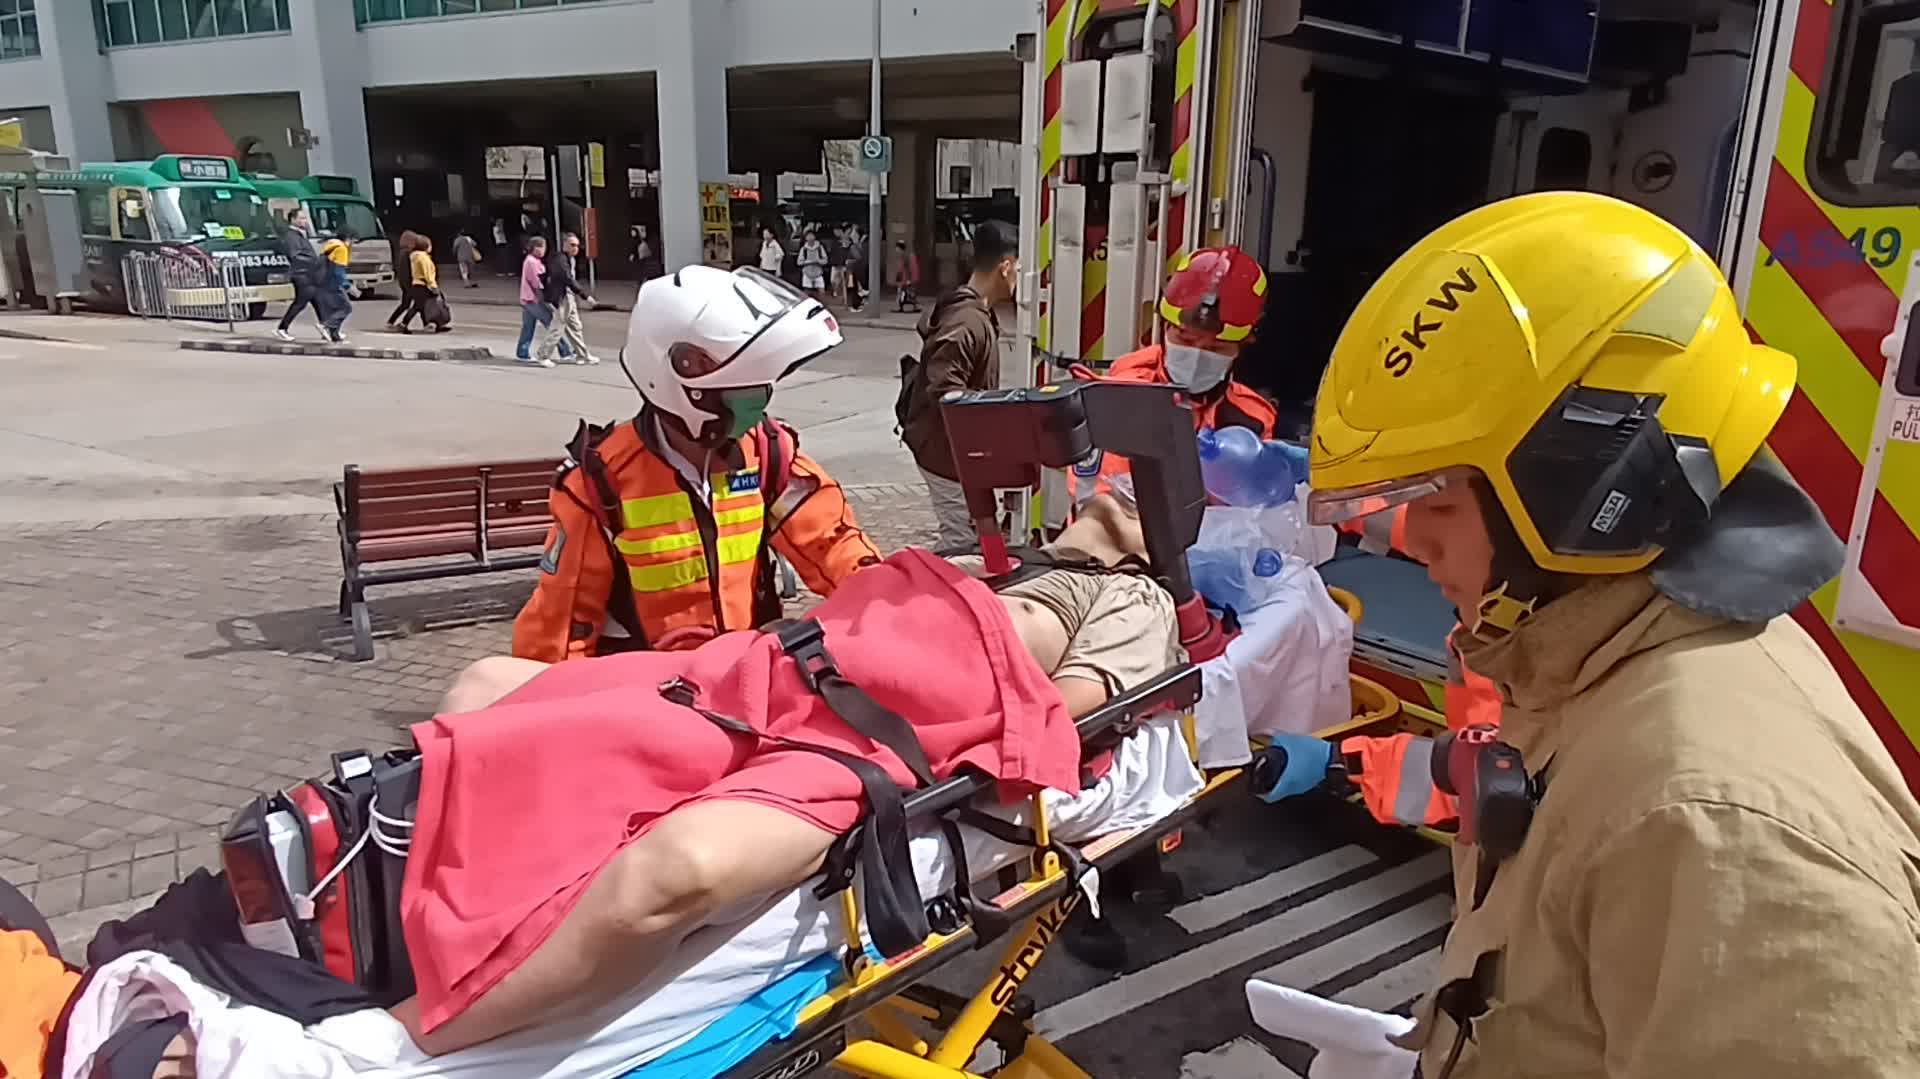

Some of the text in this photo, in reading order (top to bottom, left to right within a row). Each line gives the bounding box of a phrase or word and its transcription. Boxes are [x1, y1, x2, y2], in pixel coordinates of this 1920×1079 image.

[1384, 266, 1477, 378] SKW
[1595, 494, 1624, 531] MSA
[991, 891, 1077, 1009] stryke
